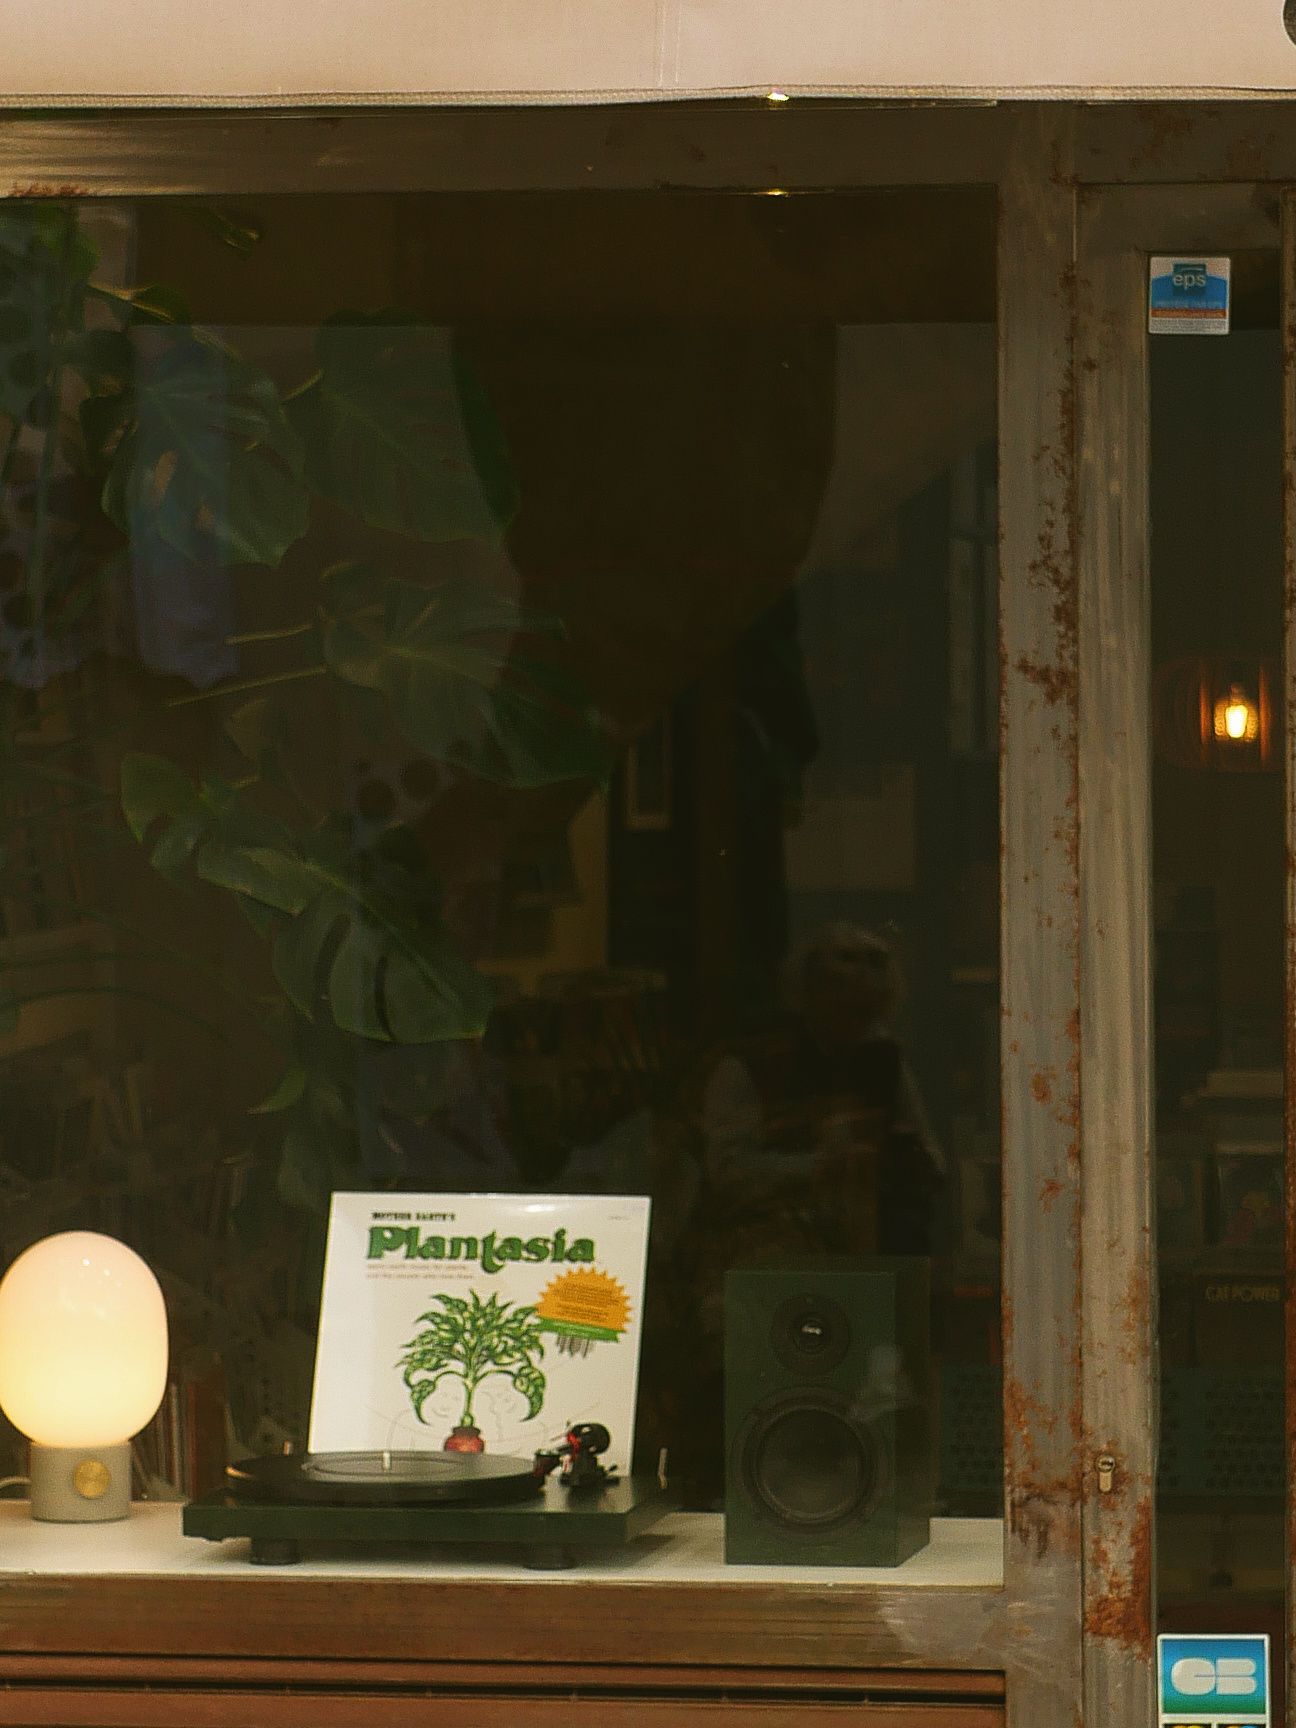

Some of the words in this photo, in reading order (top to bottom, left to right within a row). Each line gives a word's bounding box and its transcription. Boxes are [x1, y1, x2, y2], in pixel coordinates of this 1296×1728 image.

[1173, 272, 1206, 291] eps
[365, 1225, 597, 1274] Plantasia
[1170, 1657, 1257, 1695] CB
